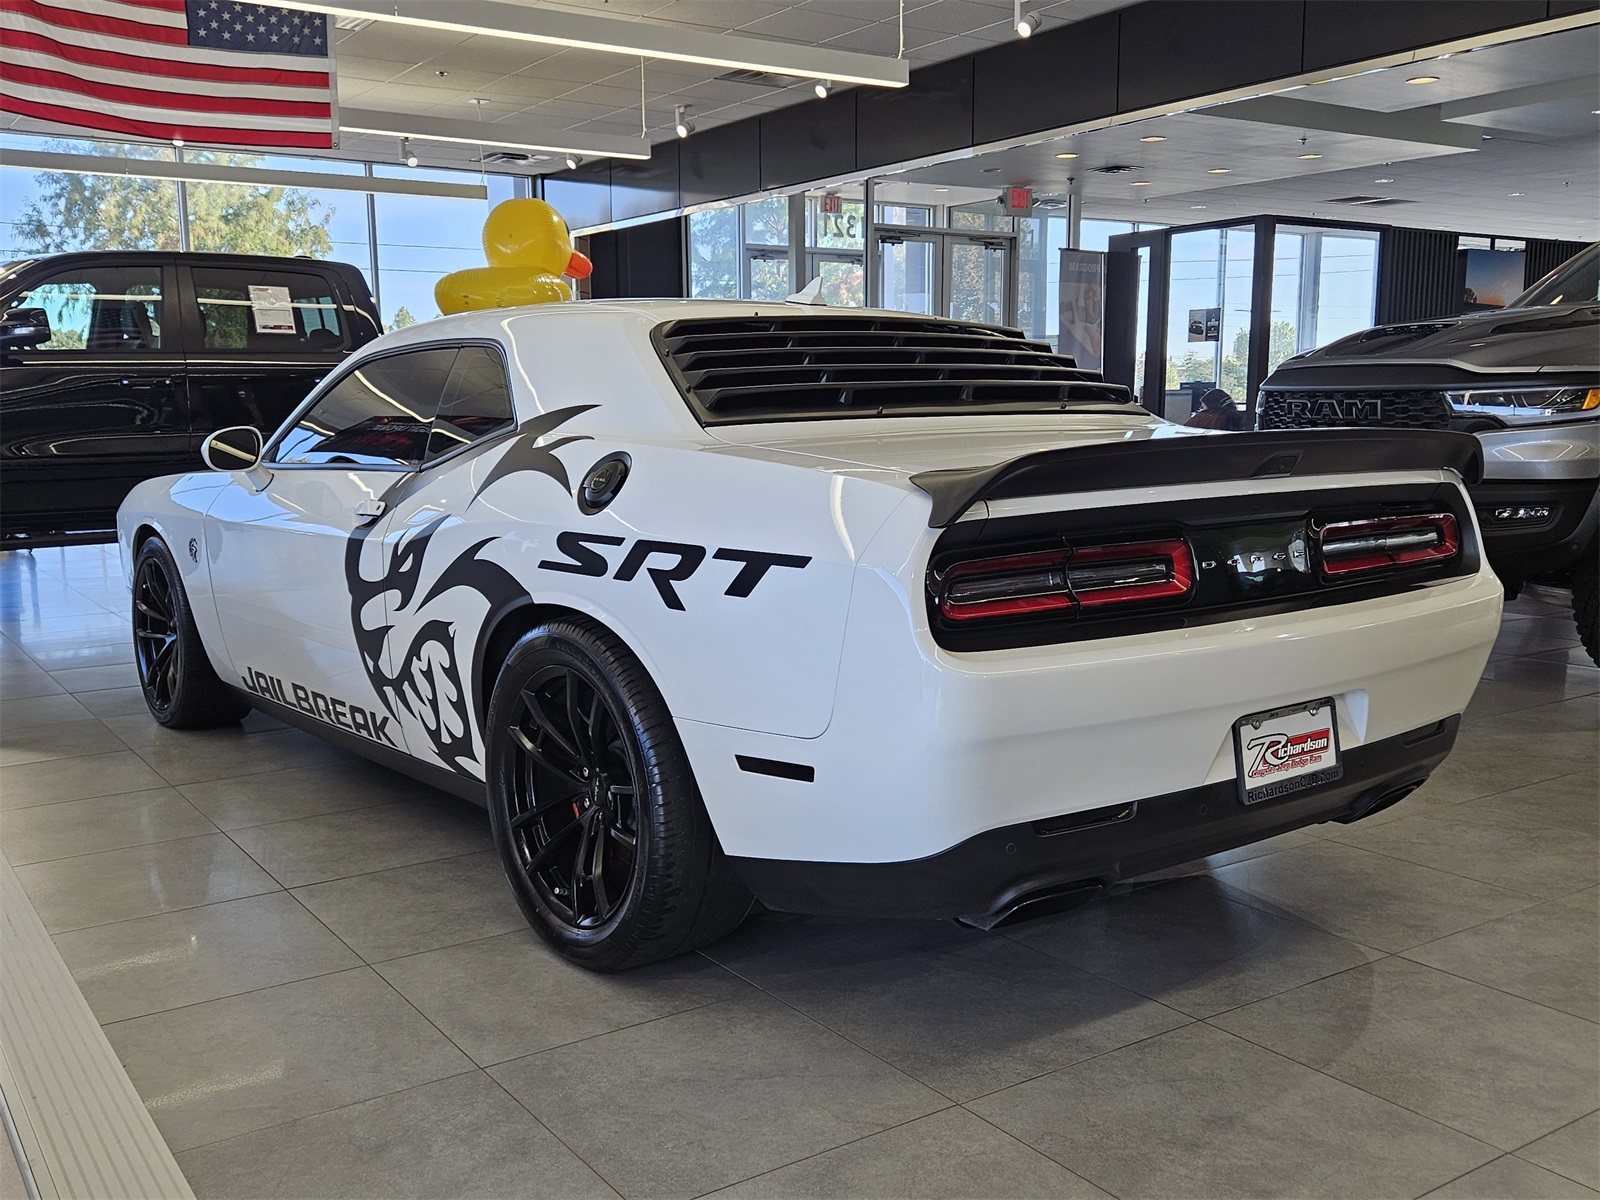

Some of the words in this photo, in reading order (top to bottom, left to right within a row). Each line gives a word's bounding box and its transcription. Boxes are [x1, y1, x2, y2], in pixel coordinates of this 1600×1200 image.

[824, 195, 839, 212] EXIT
[1011, 189, 1030, 208] EXIT
[1286, 399, 1381, 419] RAM
[537, 530, 813, 612] SRT
[241, 666, 399, 748] JAILBREAK
[1247, 733, 1328, 778] Richardson
[1247, 769, 1339, 803] RichardsonCJD.com
